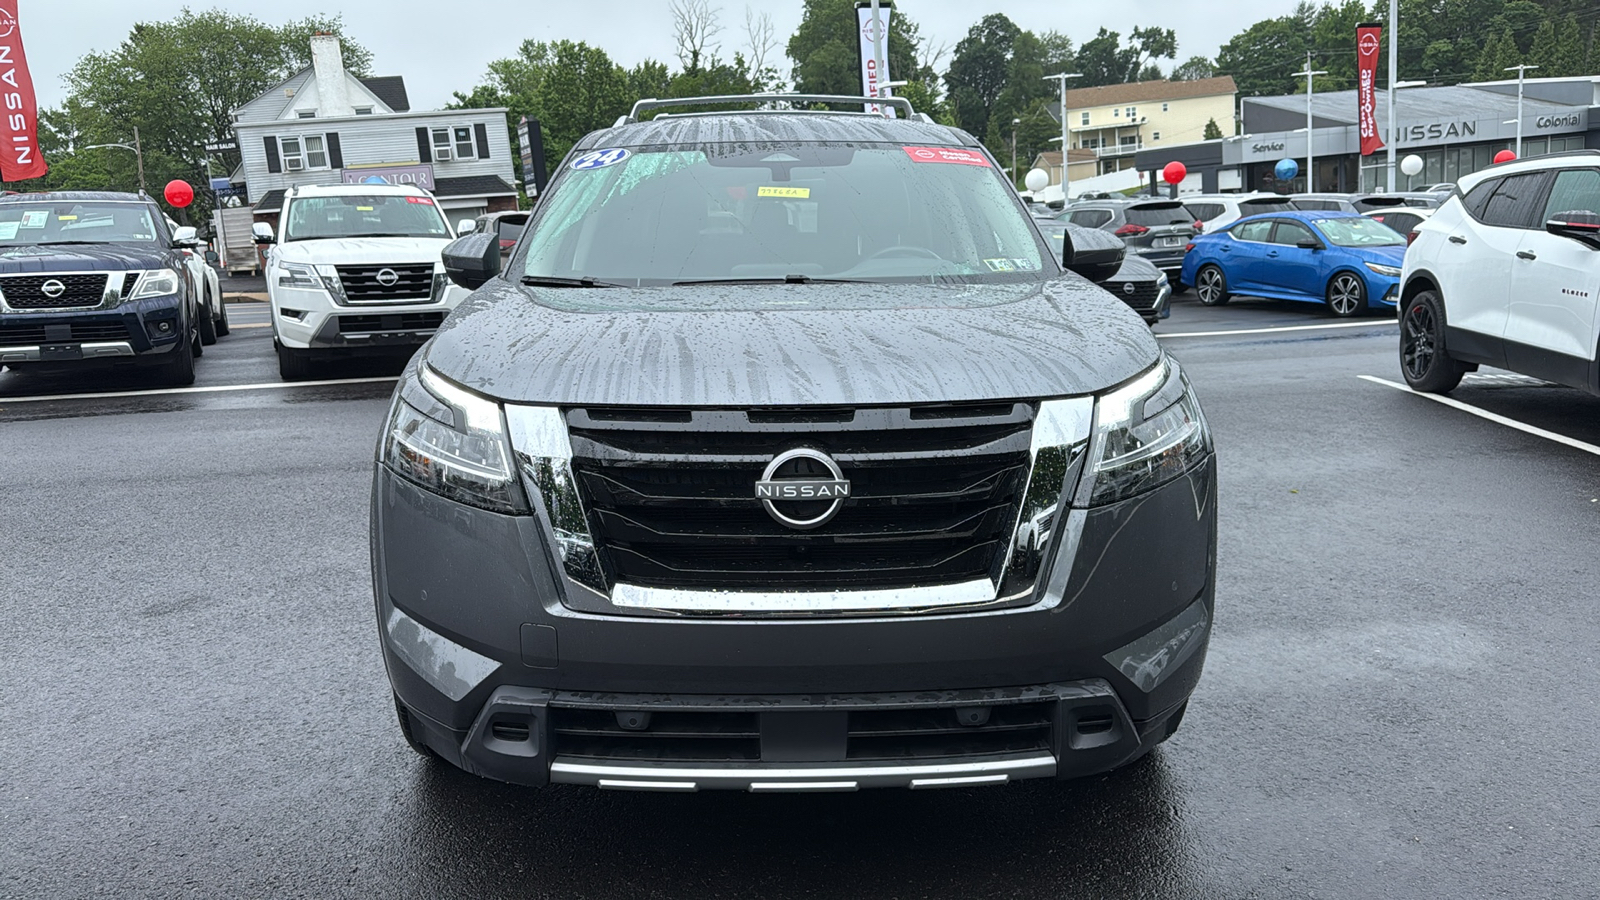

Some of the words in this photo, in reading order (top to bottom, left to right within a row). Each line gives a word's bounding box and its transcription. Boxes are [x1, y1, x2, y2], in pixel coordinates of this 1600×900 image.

[0, 46, 33, 165] NISSAN
[1536, 113, 1582, 129] Colonial
[1385, 120, 1477, 144] NISSAN
[219, 142, 237, 150] SALON
[1252, 142, 1285, 153] Service
[577, 149, 622, 169] 24
[1562, 288, 1589, 298] BLAZER
[757, 484, 849, 497] NISSAN
